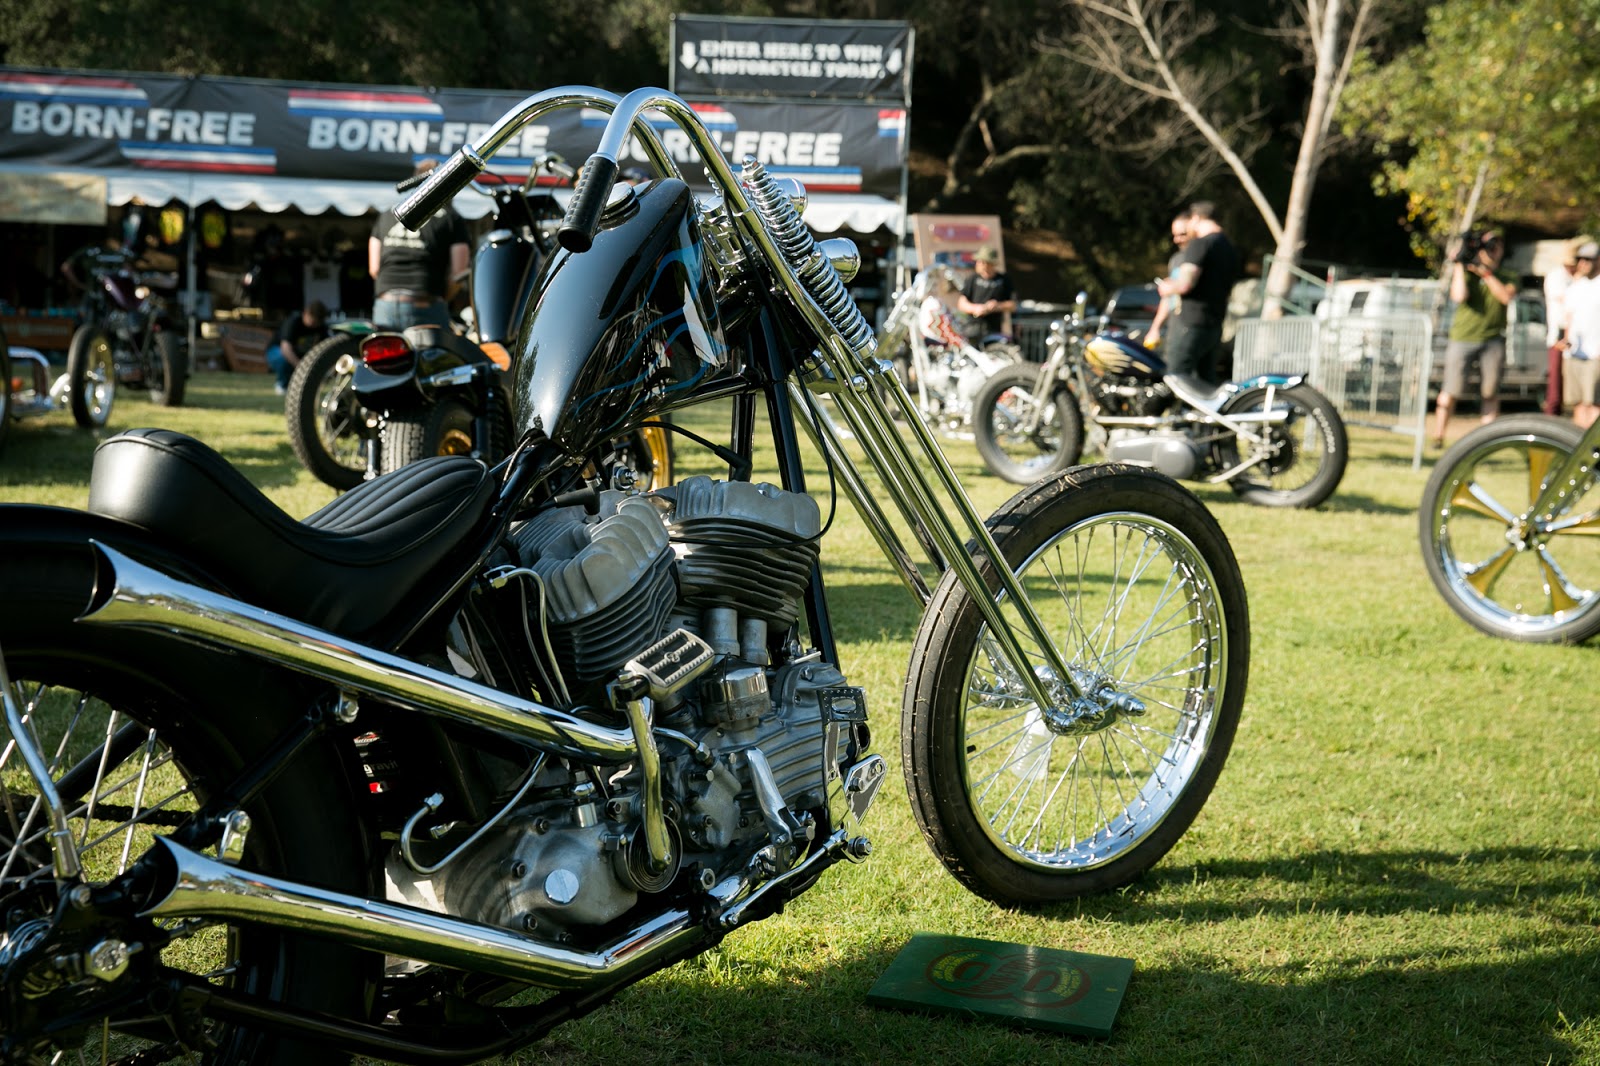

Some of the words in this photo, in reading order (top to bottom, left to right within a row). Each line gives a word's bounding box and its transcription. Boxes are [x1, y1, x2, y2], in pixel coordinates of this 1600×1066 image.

[700, 40, 760, 58] ENTER
[763, 42, 814, 60] HERE
[815, 44, 841, 61] TO
[843, 44, 883, 62] WIN
[696, 58, 711, 74] A
[711, 58, 823, 77] MOTORCYCLE
[11, 101, 256, 145] BORN-FREE
